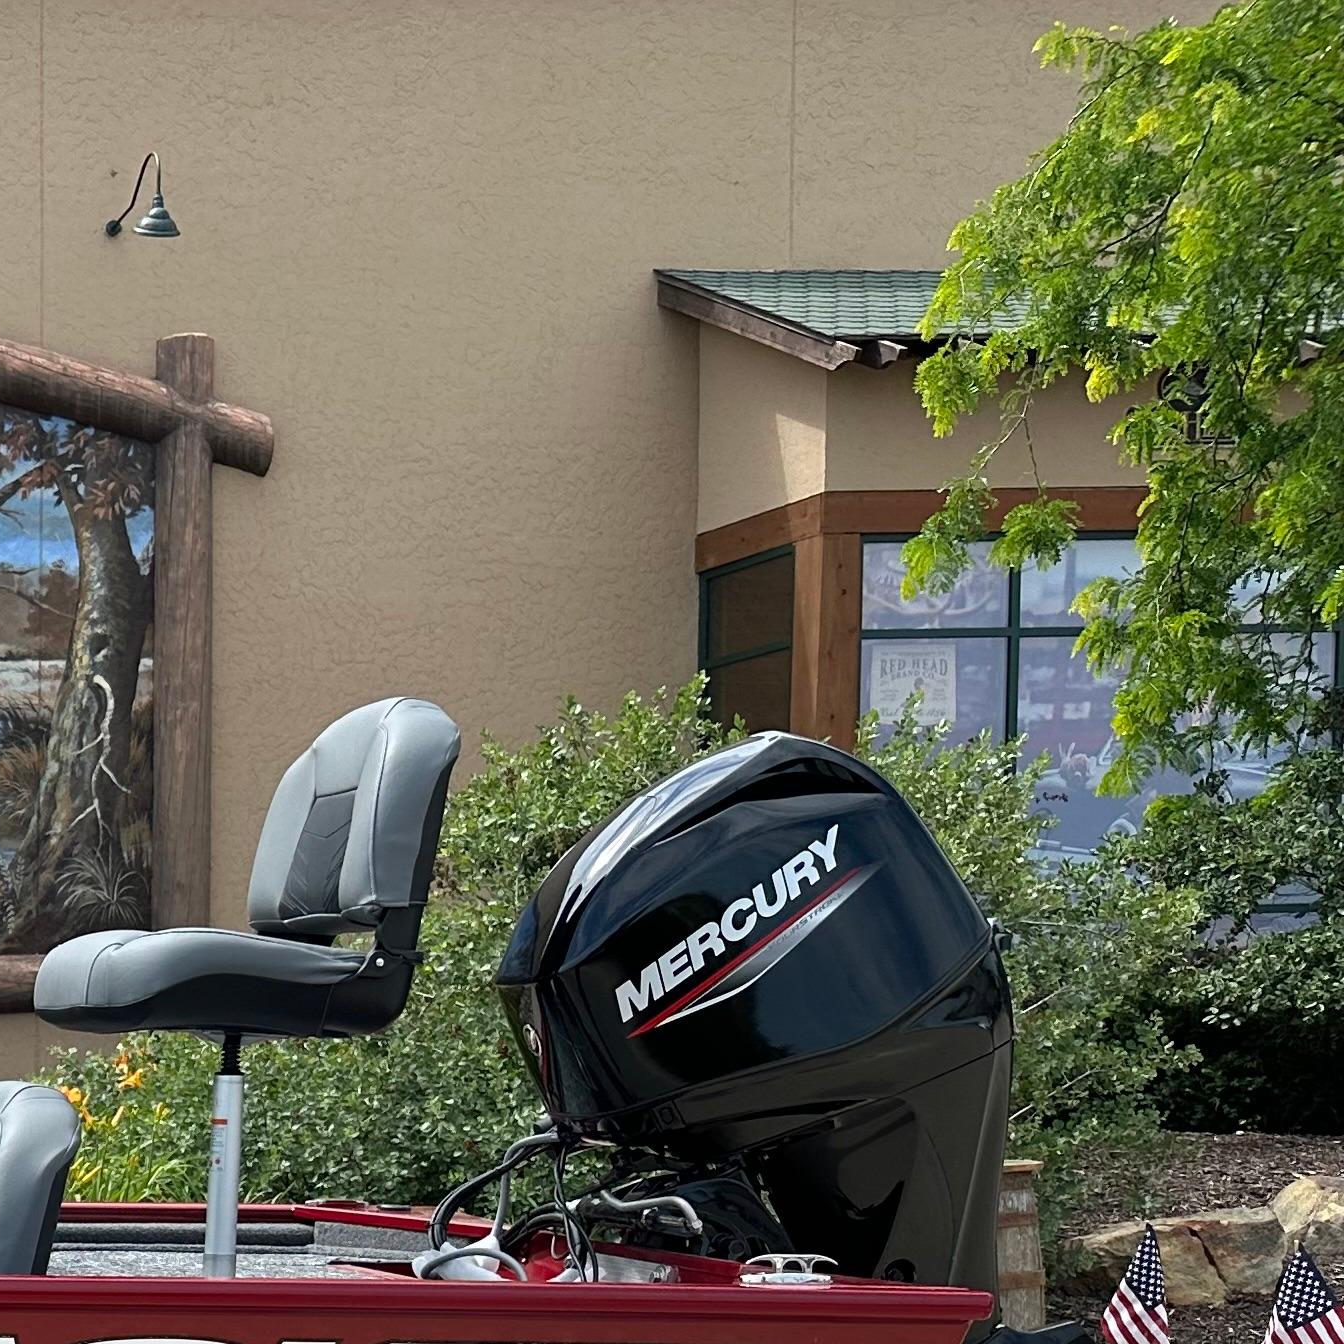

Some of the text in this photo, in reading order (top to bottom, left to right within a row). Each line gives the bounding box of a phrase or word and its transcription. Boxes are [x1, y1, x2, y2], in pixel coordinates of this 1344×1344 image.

[880, 658, 948, 679] RED HEAD
[615, 823, 839, 1023] MERCURY
